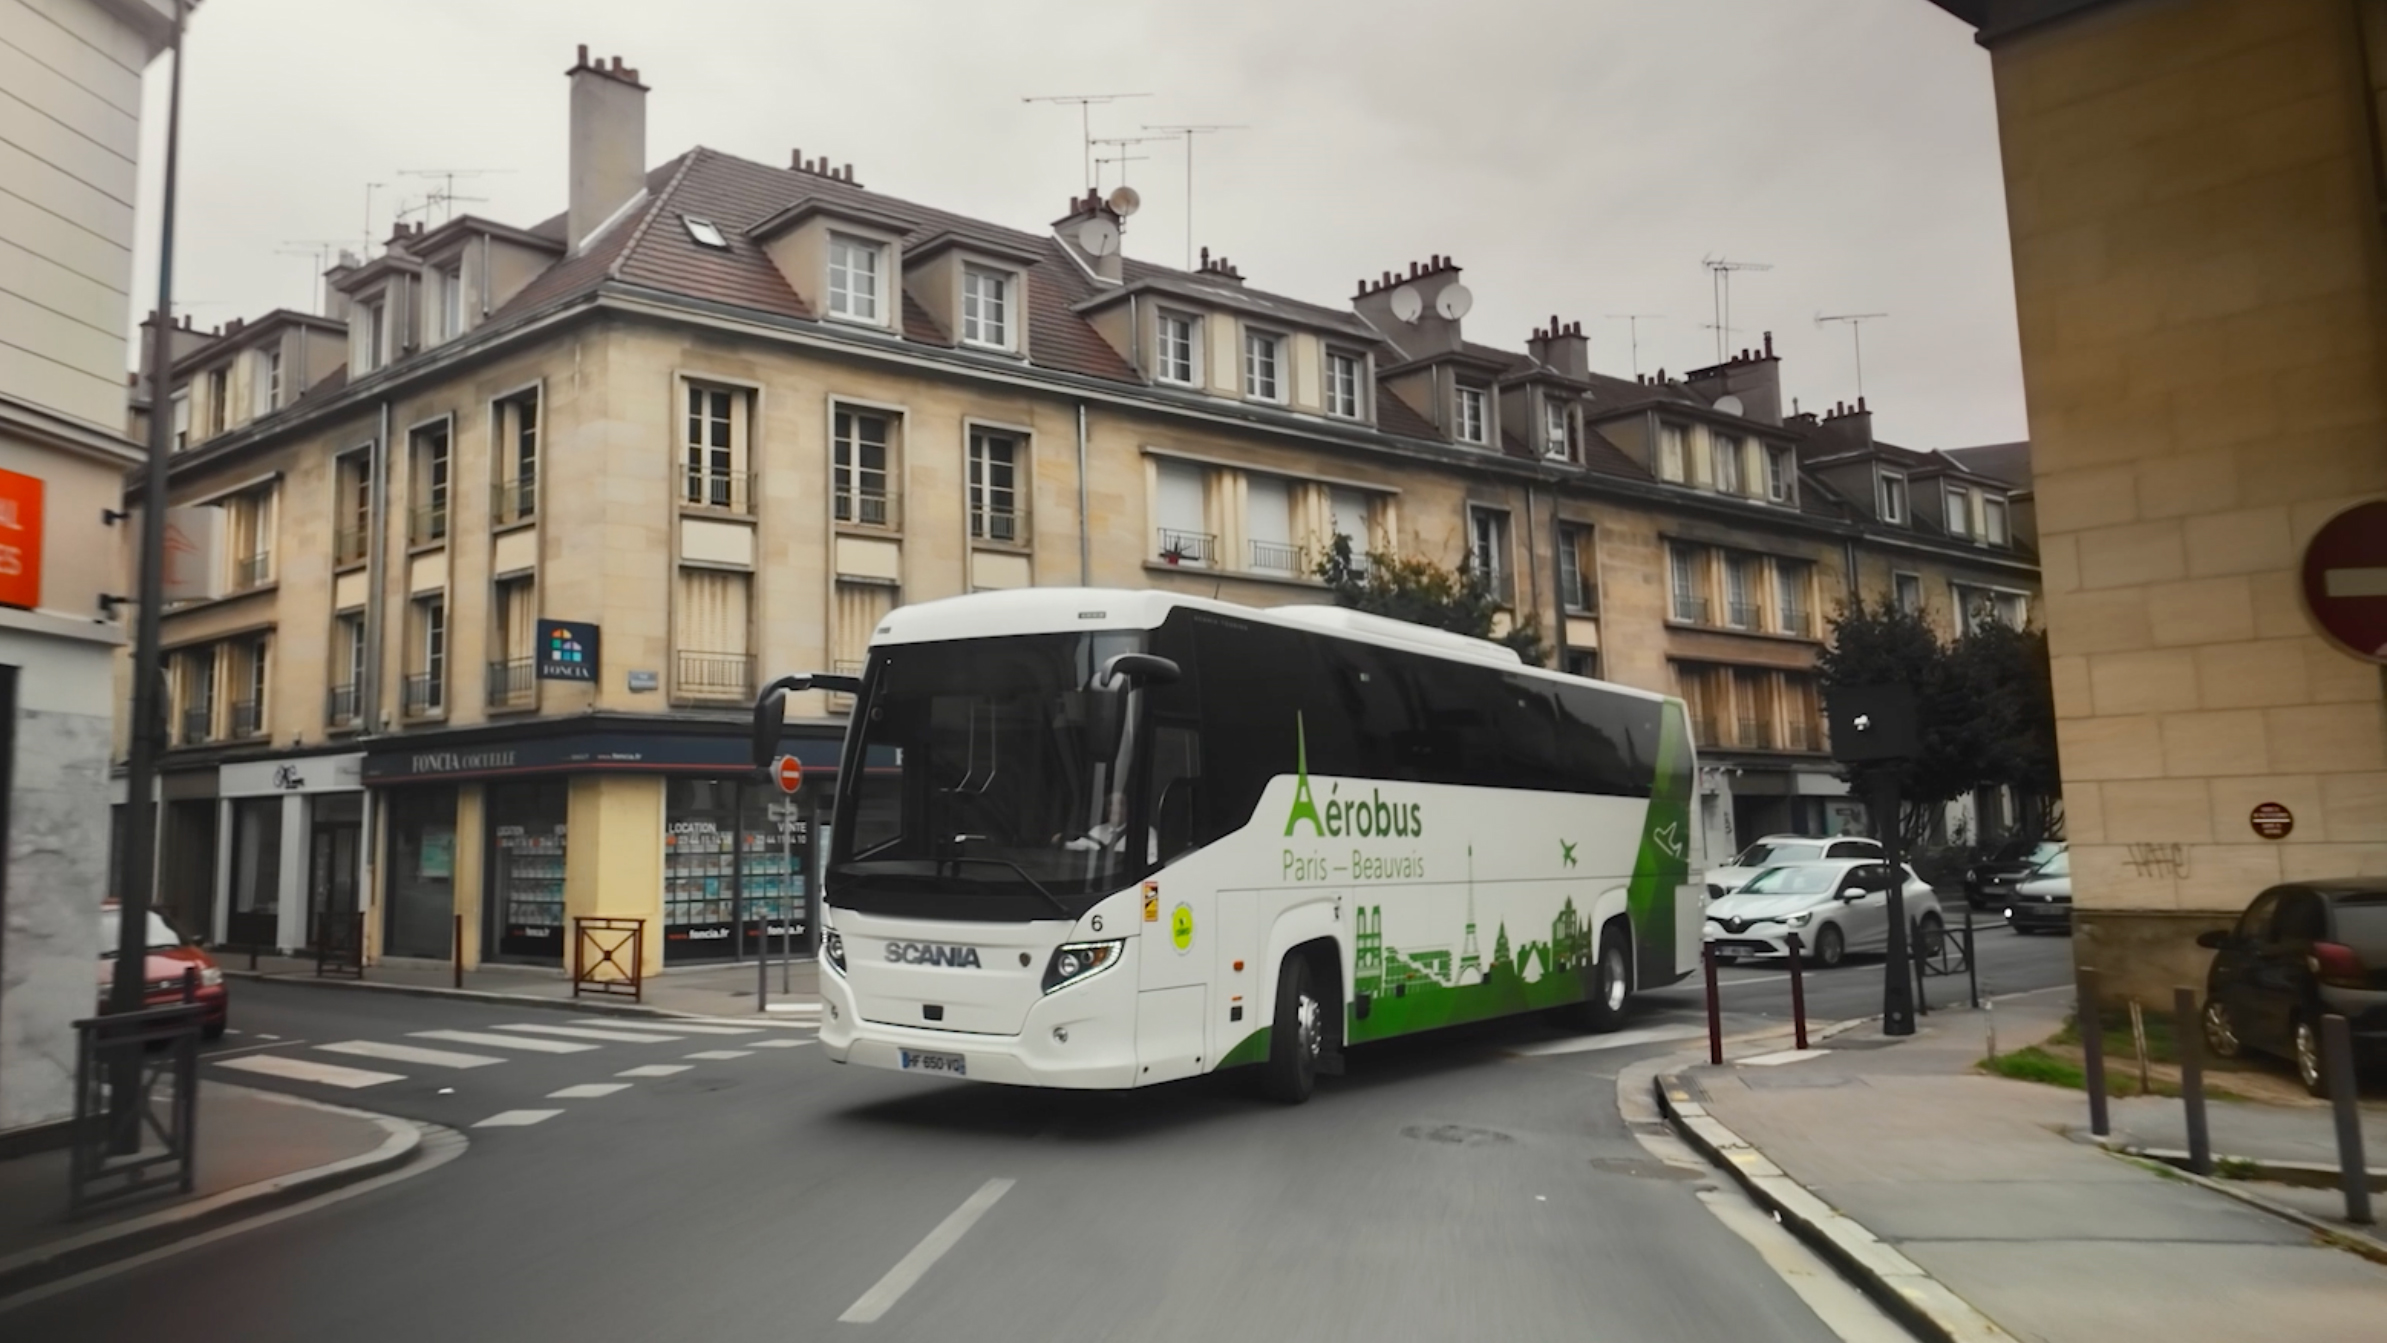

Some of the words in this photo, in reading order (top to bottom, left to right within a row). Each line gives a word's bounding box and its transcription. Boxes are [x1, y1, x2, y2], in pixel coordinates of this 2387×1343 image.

[543, 664, 590, 679] FONCIA
[412, 753, 460, 774] FONCIA
[668, 822, 717, 834] LOCATION
[777, 821, 807, 833] VNTE
[1283, 849, 1328, 882] Paris
[1353, 849, 1425, 880] Beauvais
[1091, 914, 1103, 932] 6
[667, 928, 730, 941] www.foncia.fr
[884, 942, 982, 970] SCANIA
